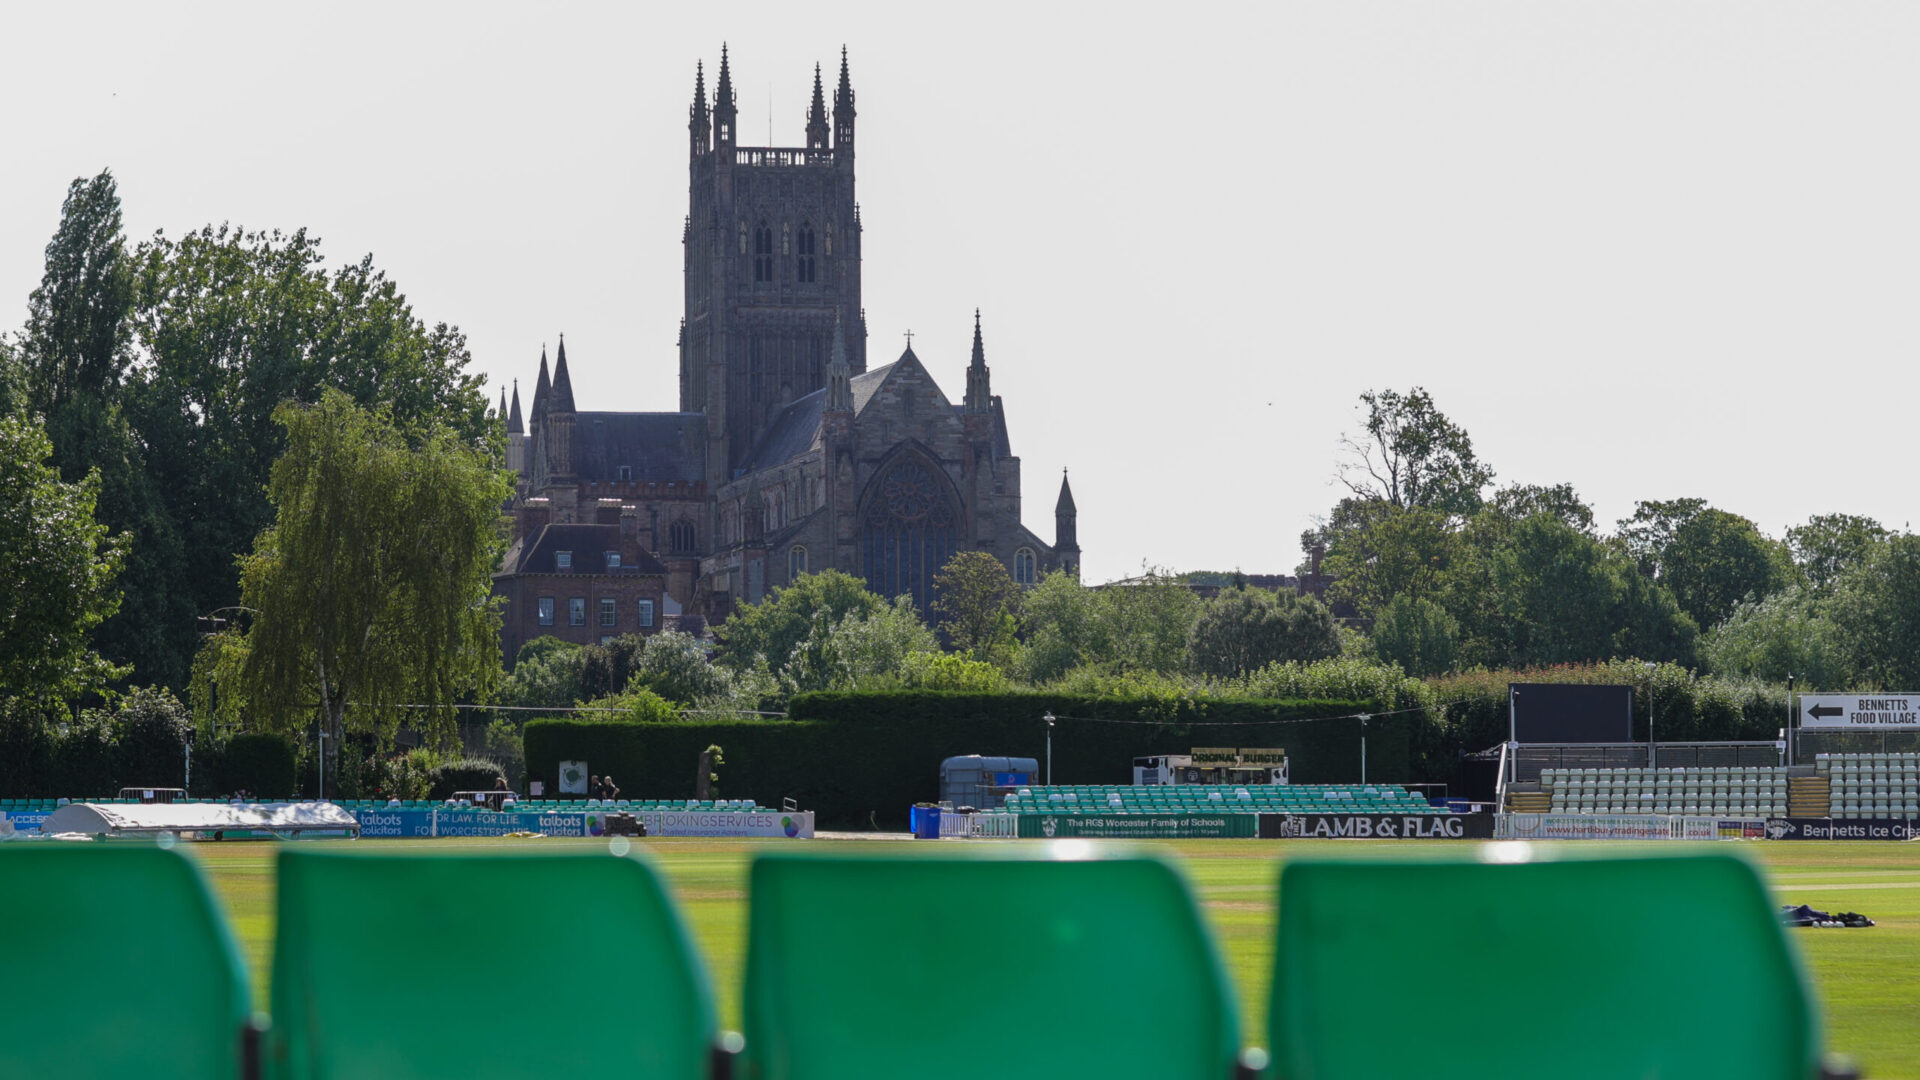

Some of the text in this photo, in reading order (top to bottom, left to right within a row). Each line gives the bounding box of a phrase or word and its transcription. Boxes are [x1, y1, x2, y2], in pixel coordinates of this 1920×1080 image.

[1859, 699, 1908, 711] BENNETTS
[1851, 712, 1917, 724] FOOD VILLAGE
[1192, 753, 1284, 763] ORIGINAL BURGER
[361, 814, 402, 825] talbots
[477, 814, 497, 824] FOR
[539, 815, 581, 826] talbots
[1067, 818, 1225, 828] The RGS Worcester Family of Schools
[361, 826, 402, 835] solicitors
[540, 827, 581, 836] solicitors
[1301, 817, 1373, 837] LAMB
[1376, 817, 1398, 837] &
[1403, 817, 1463, 837] FLAG
[1803, 825, 1865, 837] Bennetts
[1869, 825, 1889, 837] Ice
